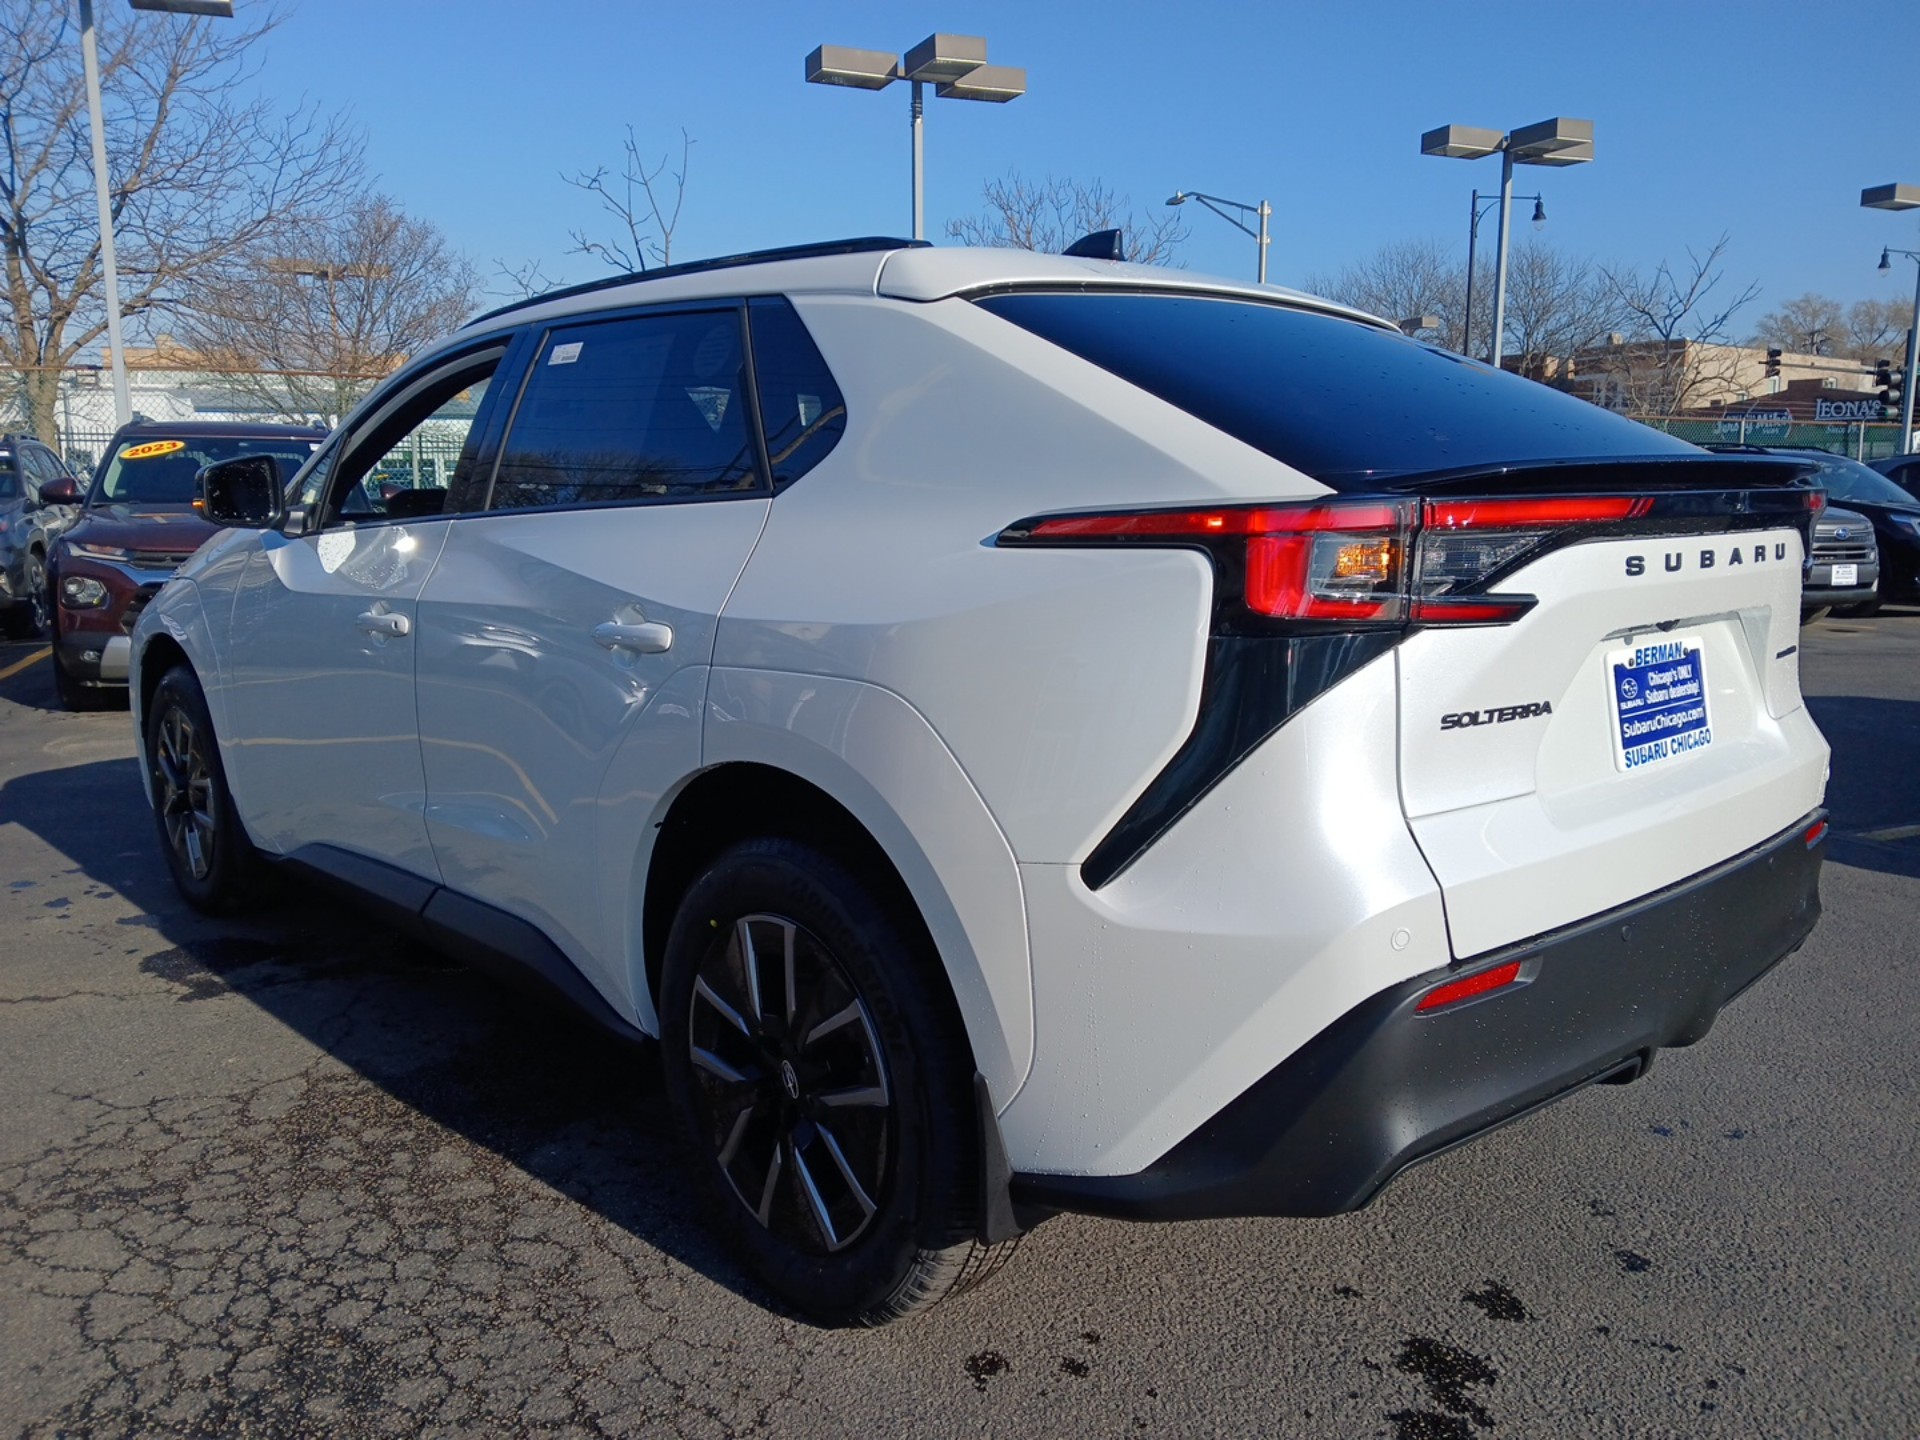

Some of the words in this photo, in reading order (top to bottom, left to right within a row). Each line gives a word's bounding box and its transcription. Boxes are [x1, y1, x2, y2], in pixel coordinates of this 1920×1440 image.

[128, 441, 178, 457] 2023
[1625, 542, 1786, 576] SUBARU
[1635, 641, 1683, 666] BERMAN
[1648, 667, 1677, 686] Chicago's
[1677, 664, 1692, 679] ONLY
[1621, 698, 1645, 710] SUBARU
[1645, 687, 1669, 704] Subaru
[1440, 701, 1552, 730] SOLTERRA
[1623, 707, 1705, 738] SubaruChicago.com
[1624, 740, 1669, 768] SUBARU
[1670, 728, 1711, 755] CHICAGO
